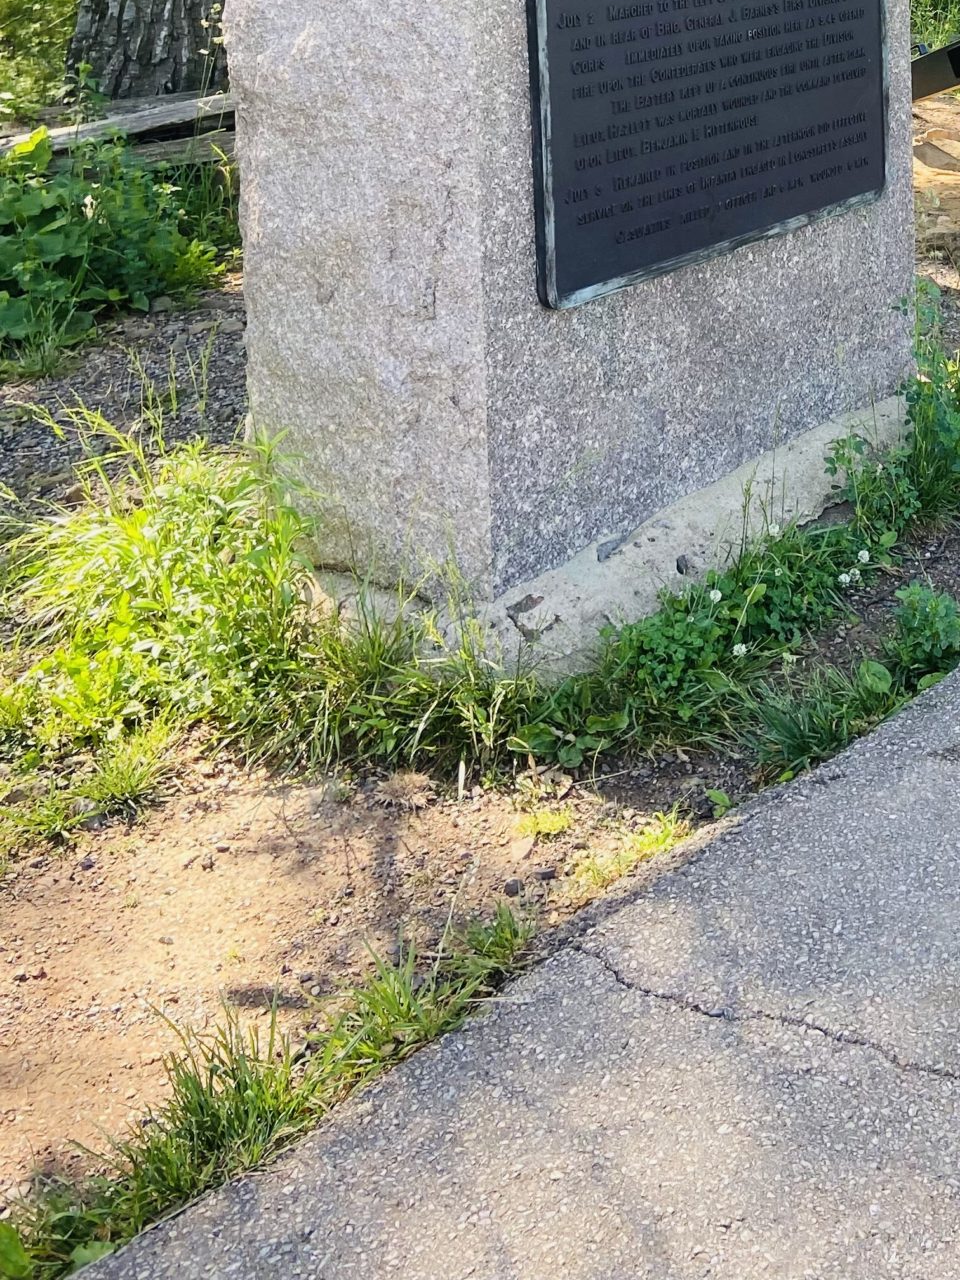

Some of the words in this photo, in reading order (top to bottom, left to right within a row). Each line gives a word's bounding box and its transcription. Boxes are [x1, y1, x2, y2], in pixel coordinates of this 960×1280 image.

[607, 0, 652, 19] MARCHED
[571, 34, 591, 51] AND
[595, 31, 605, 47] IN
[640, 23, 653, 39] OF
[686, 12, 723, 29] GENERAL
[689, 36, 710, 51] UPON
[714, 30, 743, 46] TAKING
[747, 23, 780, 39] POSITION
[598, 76, 623, 93] UPON
[626, 70, 645, 88] THE
